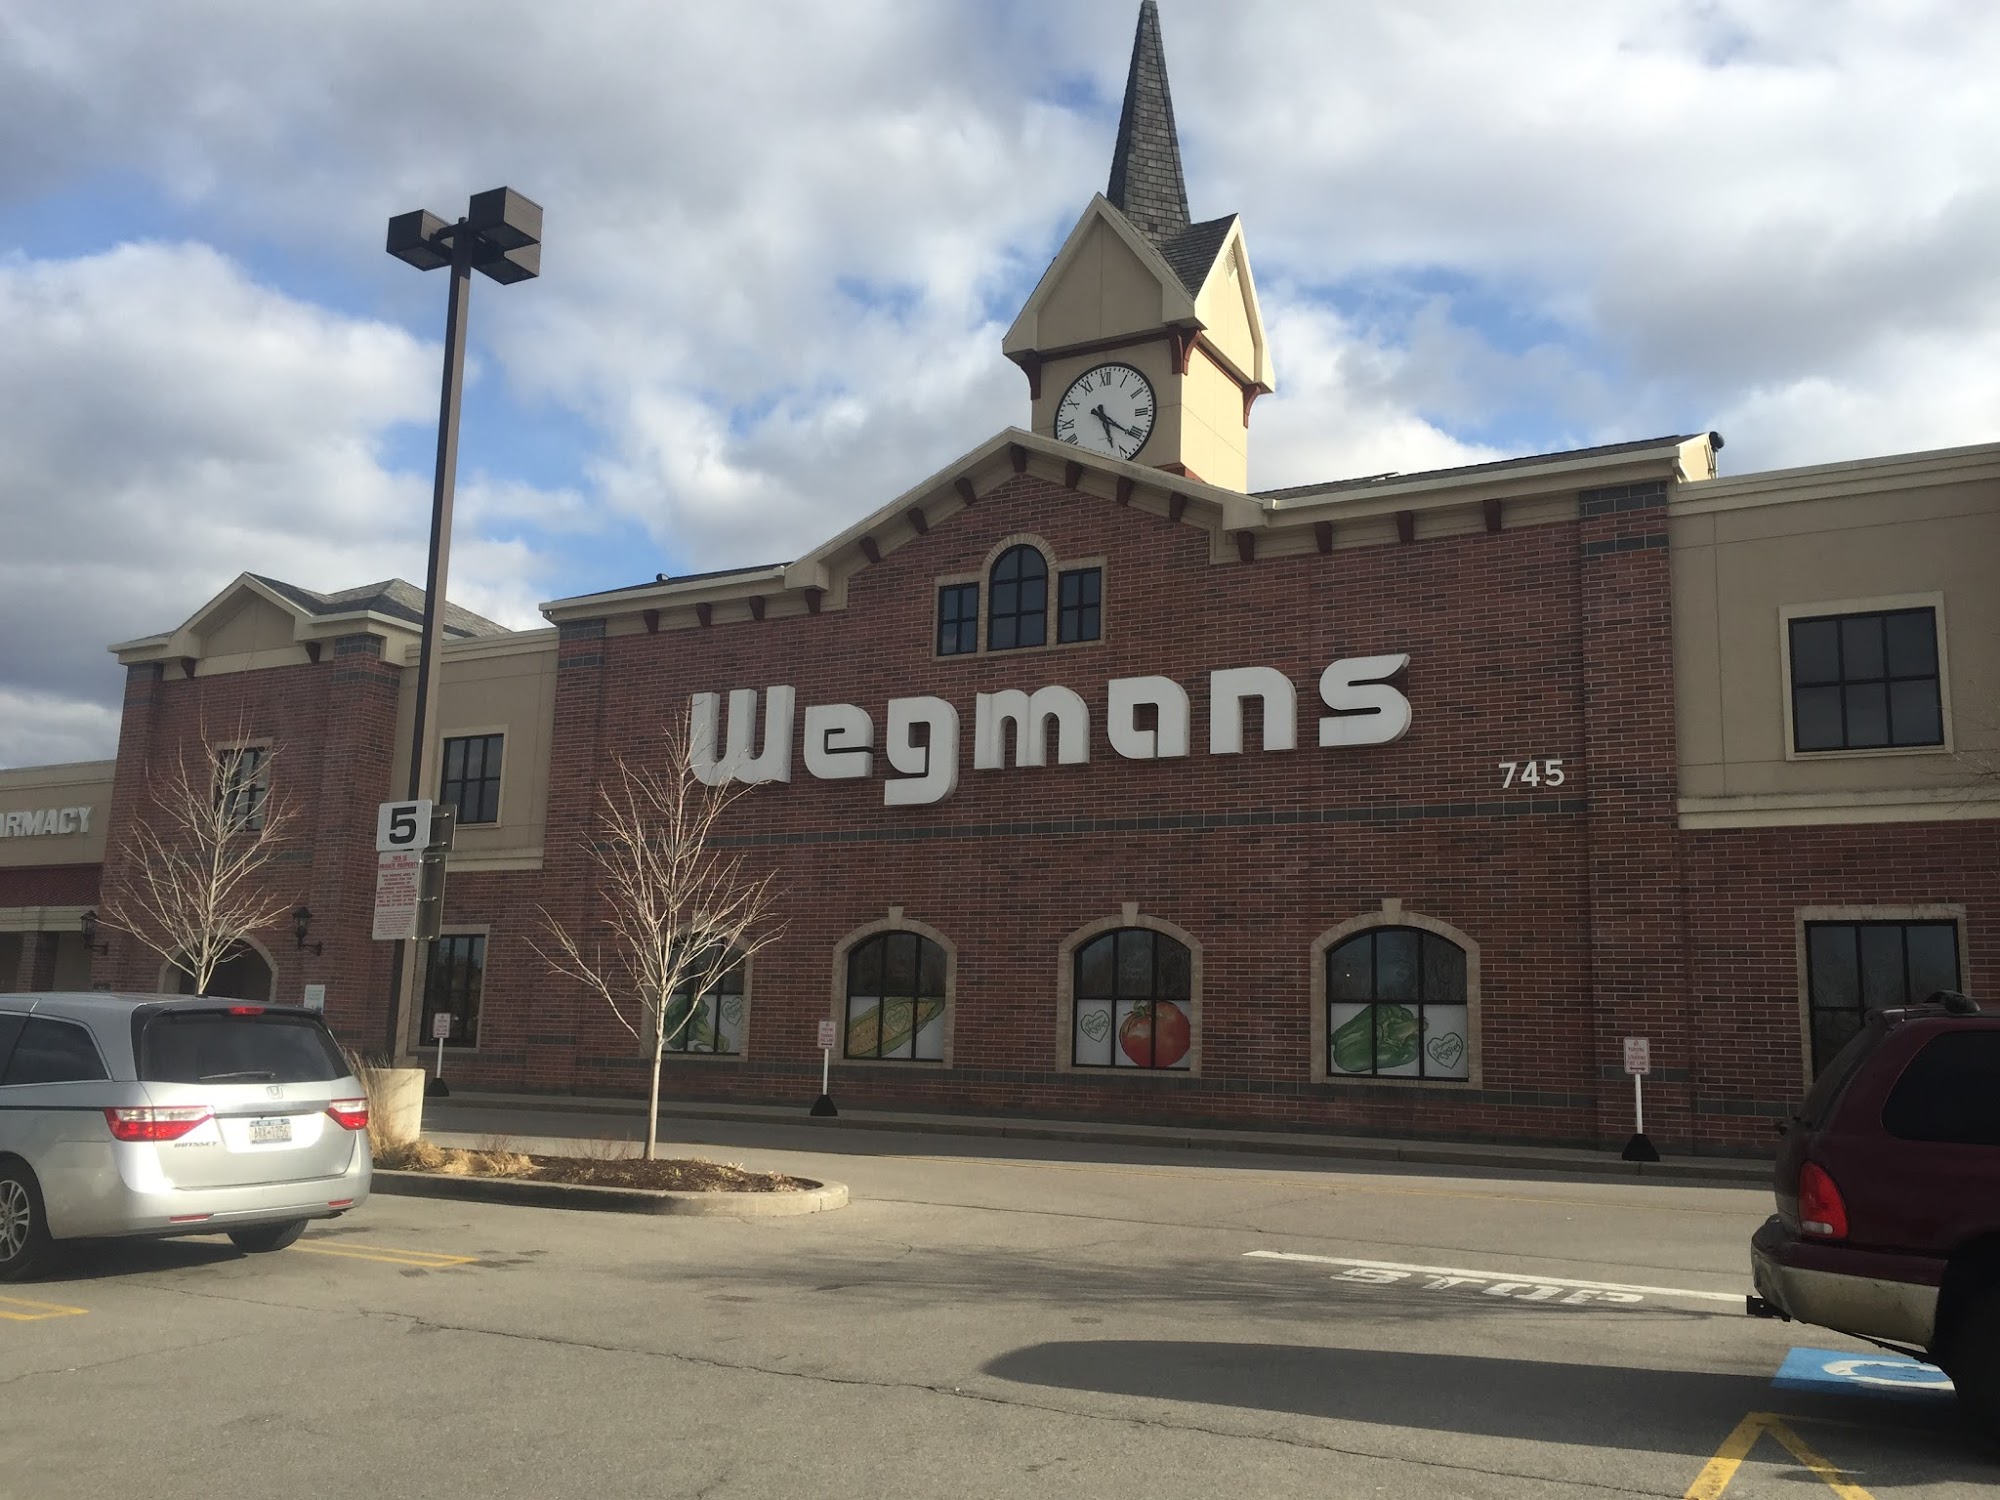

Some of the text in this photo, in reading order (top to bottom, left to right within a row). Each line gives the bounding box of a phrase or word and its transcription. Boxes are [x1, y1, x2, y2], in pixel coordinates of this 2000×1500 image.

[689, 653, 1412, 806] Wegmans
[1498, 760, 1565, 789] 745
[389, 806, 417, 845] 5
[1329, 1268, 1645, 1304] STOP
